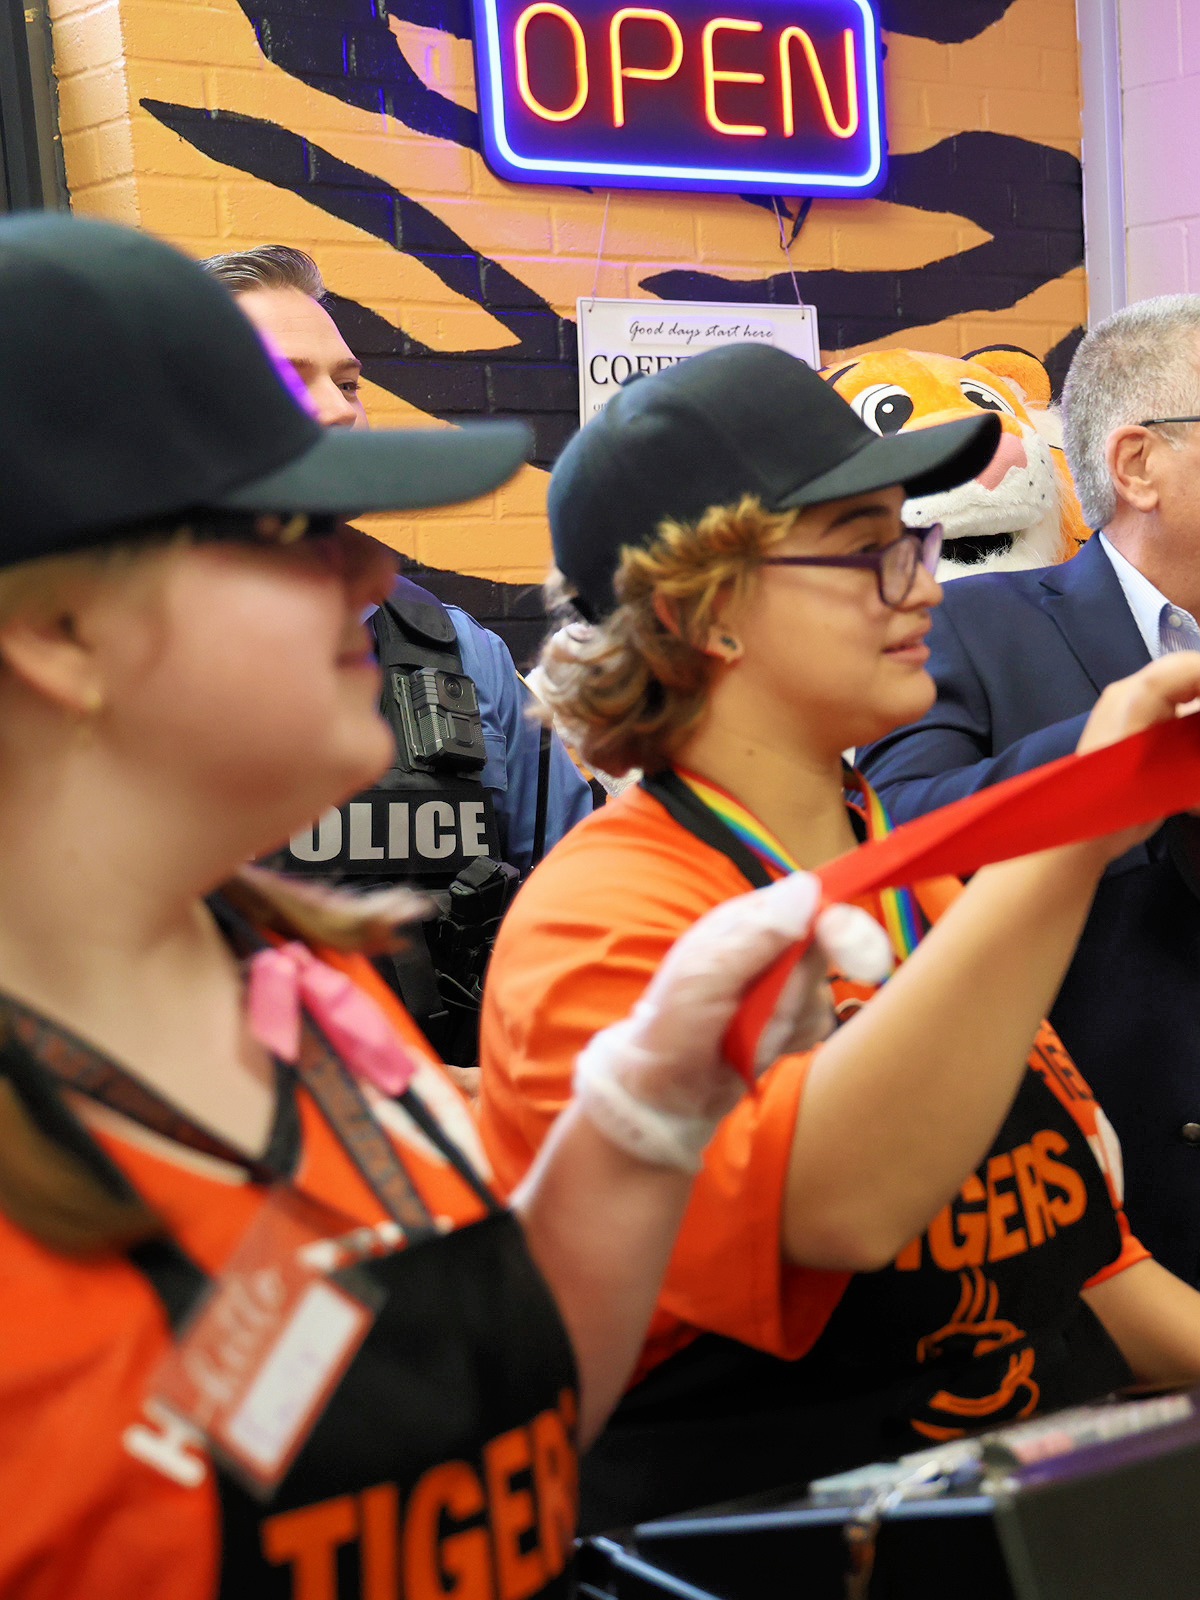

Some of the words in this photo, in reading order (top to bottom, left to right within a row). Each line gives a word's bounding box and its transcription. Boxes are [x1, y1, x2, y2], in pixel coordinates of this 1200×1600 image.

[513, 1, 860, 139] OPEN
[629, 321, 664, 341] Good
[668, 322, 701, 344] days
[705, 324, 740, 338] start
[743, 323, 774, 338] here
[289, 800, 490, 862] OLICE
[895, 1129, 1088, 1272] GERS
[261, 1386, 581, 1600] TIGER
